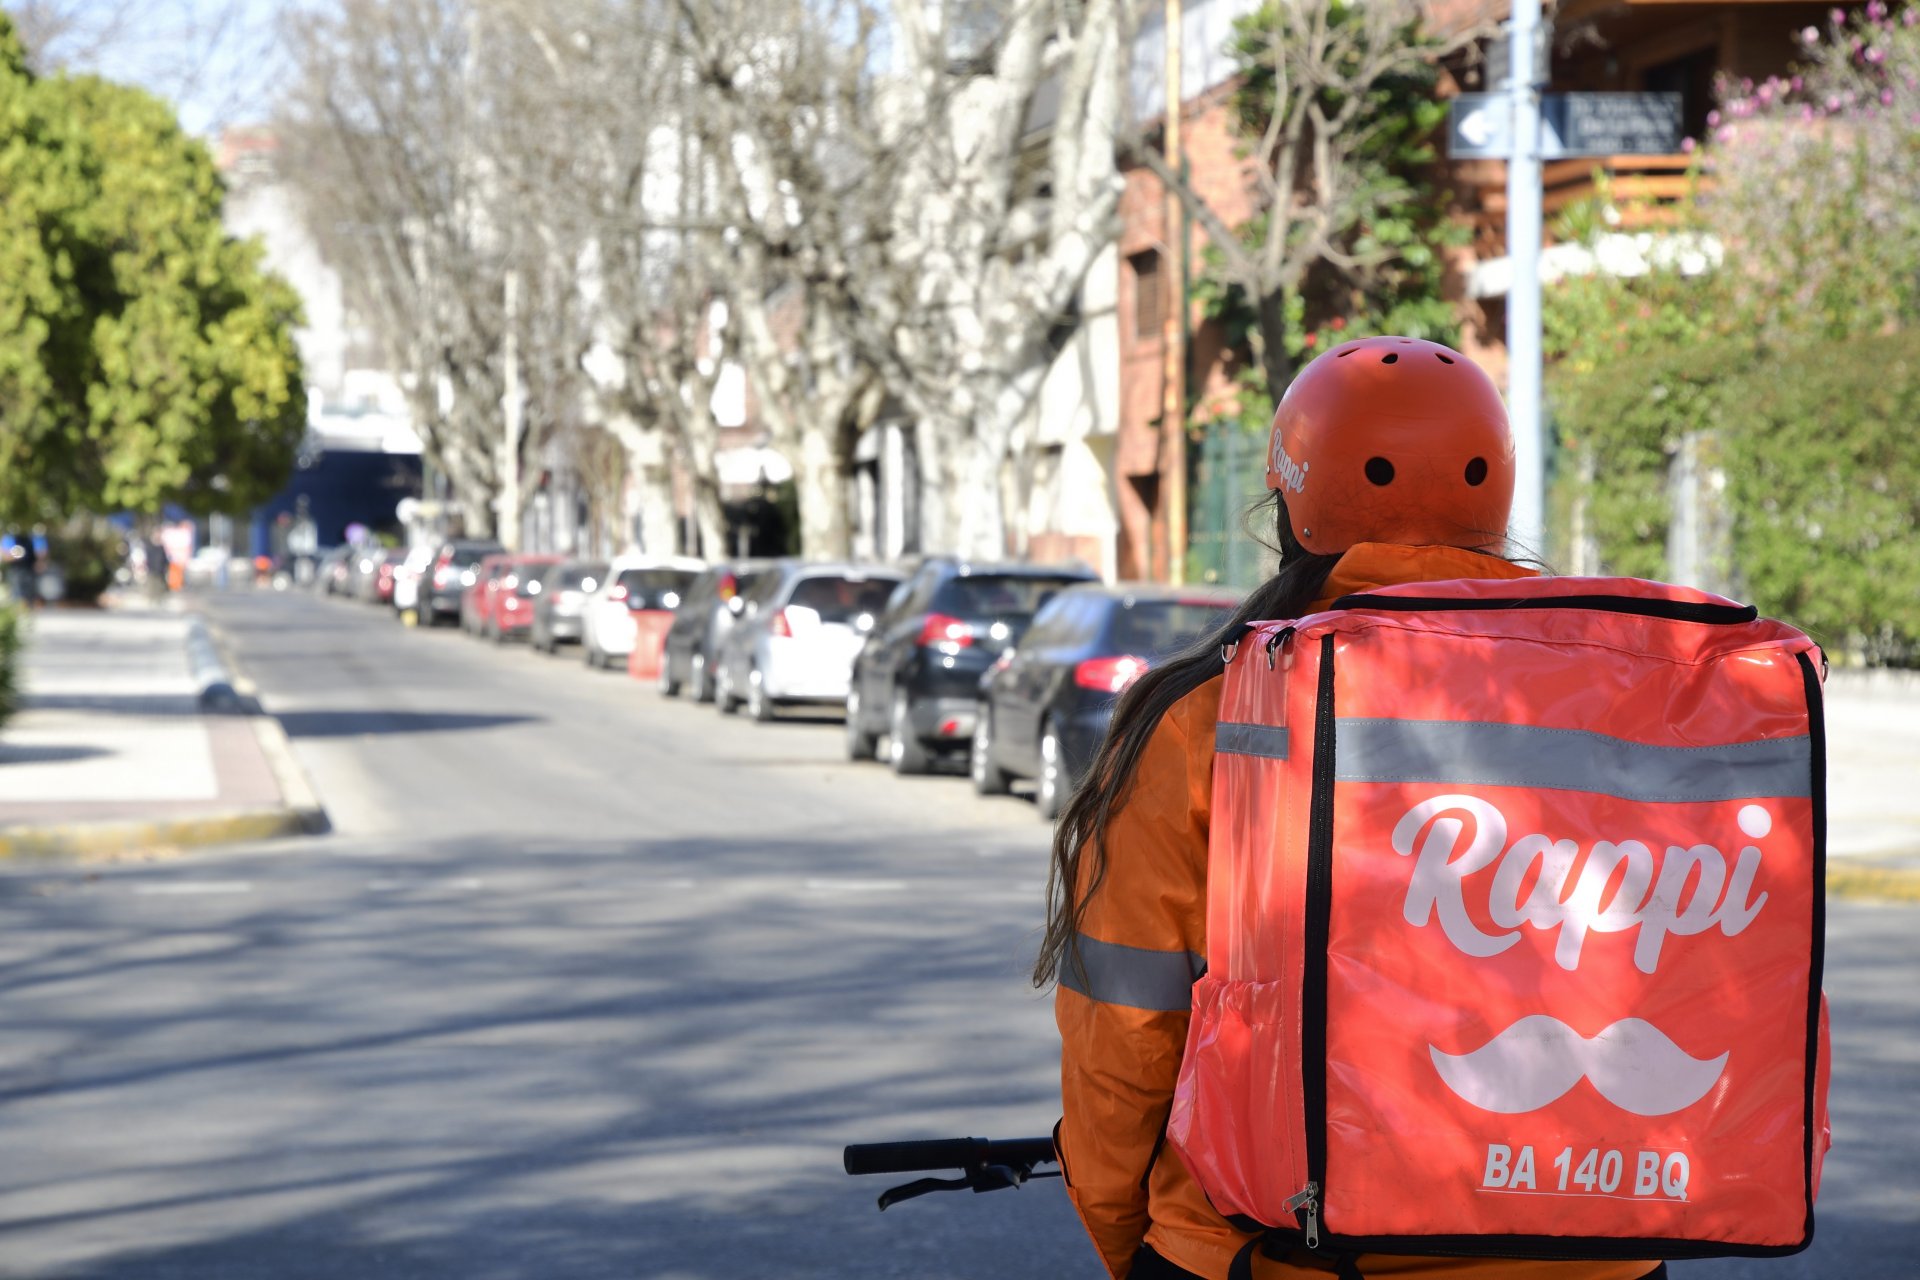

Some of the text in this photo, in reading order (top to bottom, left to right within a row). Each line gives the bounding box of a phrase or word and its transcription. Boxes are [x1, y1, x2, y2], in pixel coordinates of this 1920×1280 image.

[1272, 428, 1309, 493] Rappi
[1391, 794, 1772, 974] Rappi
[1483, 1144, 1690, 1201] BA 140 BQ
